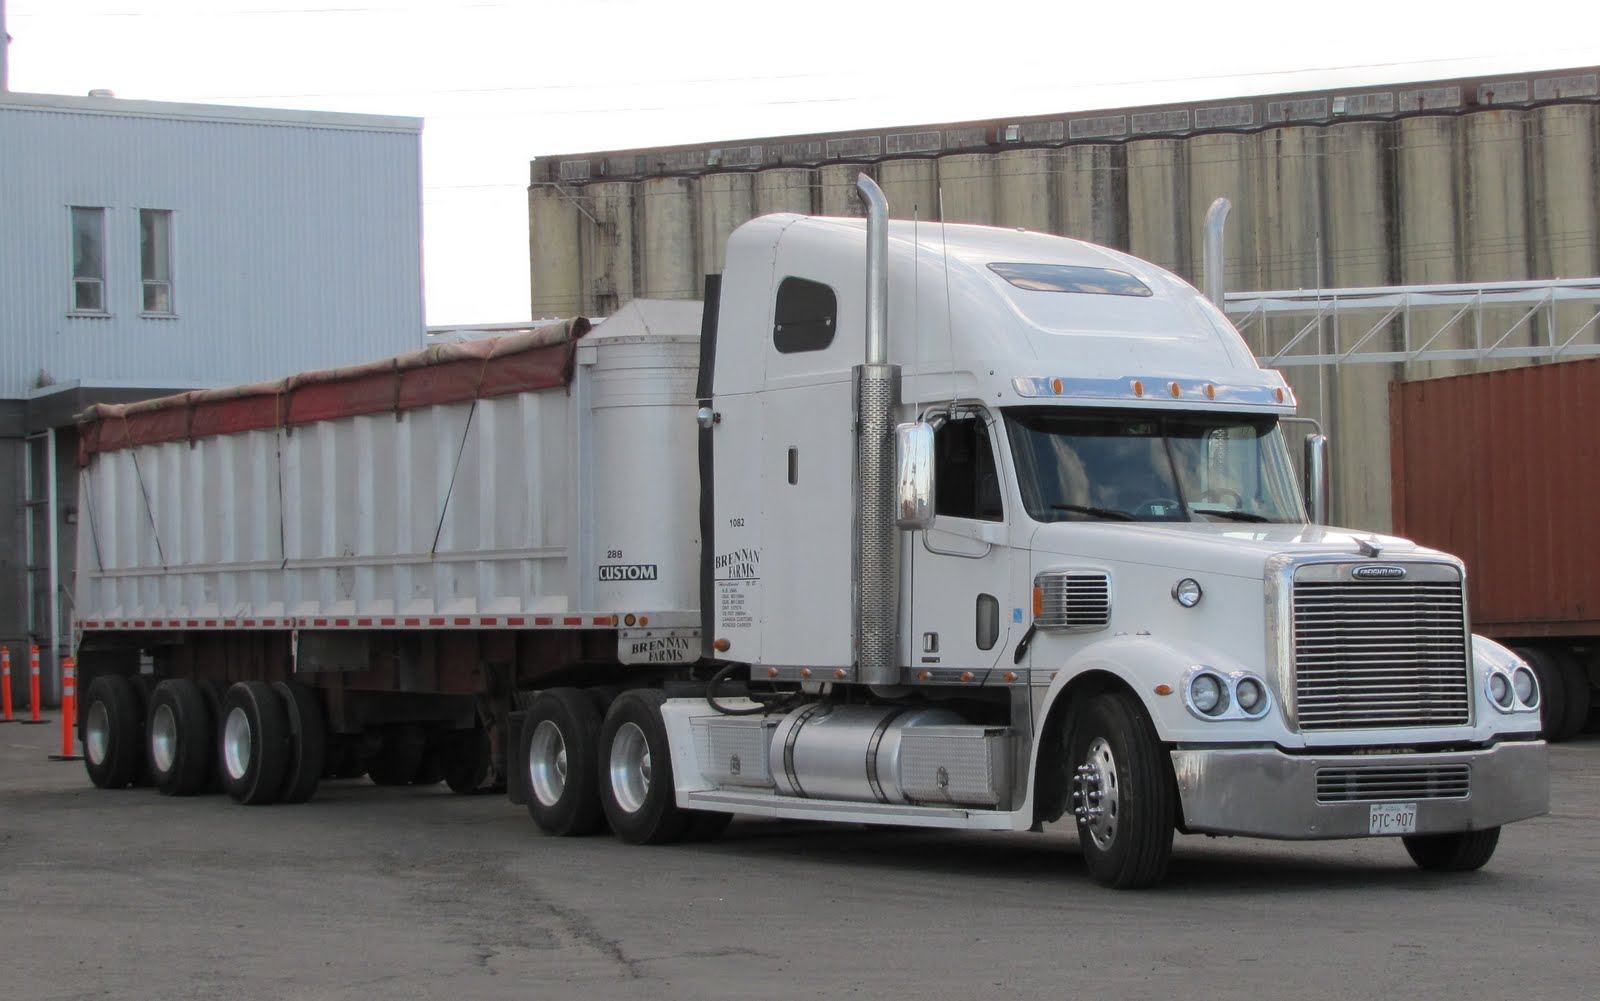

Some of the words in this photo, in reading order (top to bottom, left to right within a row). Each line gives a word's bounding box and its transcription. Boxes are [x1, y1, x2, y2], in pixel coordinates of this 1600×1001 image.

[729, 518, 745, 527] 1082
[607, 550, 623, 559] 288
[715, 548, 760, 569] BRENNAN
[599, 566, 656, 580] CUSTOM
[728, 563, 755, 578] FARMS
[1360, 568, 1402, 576] FREIGHTLINER
[632, 637, 689, 654] BRENNAN
[648, 649, 683, 661] FARMS
[1371, 812, 1414, 828] PTC-907
